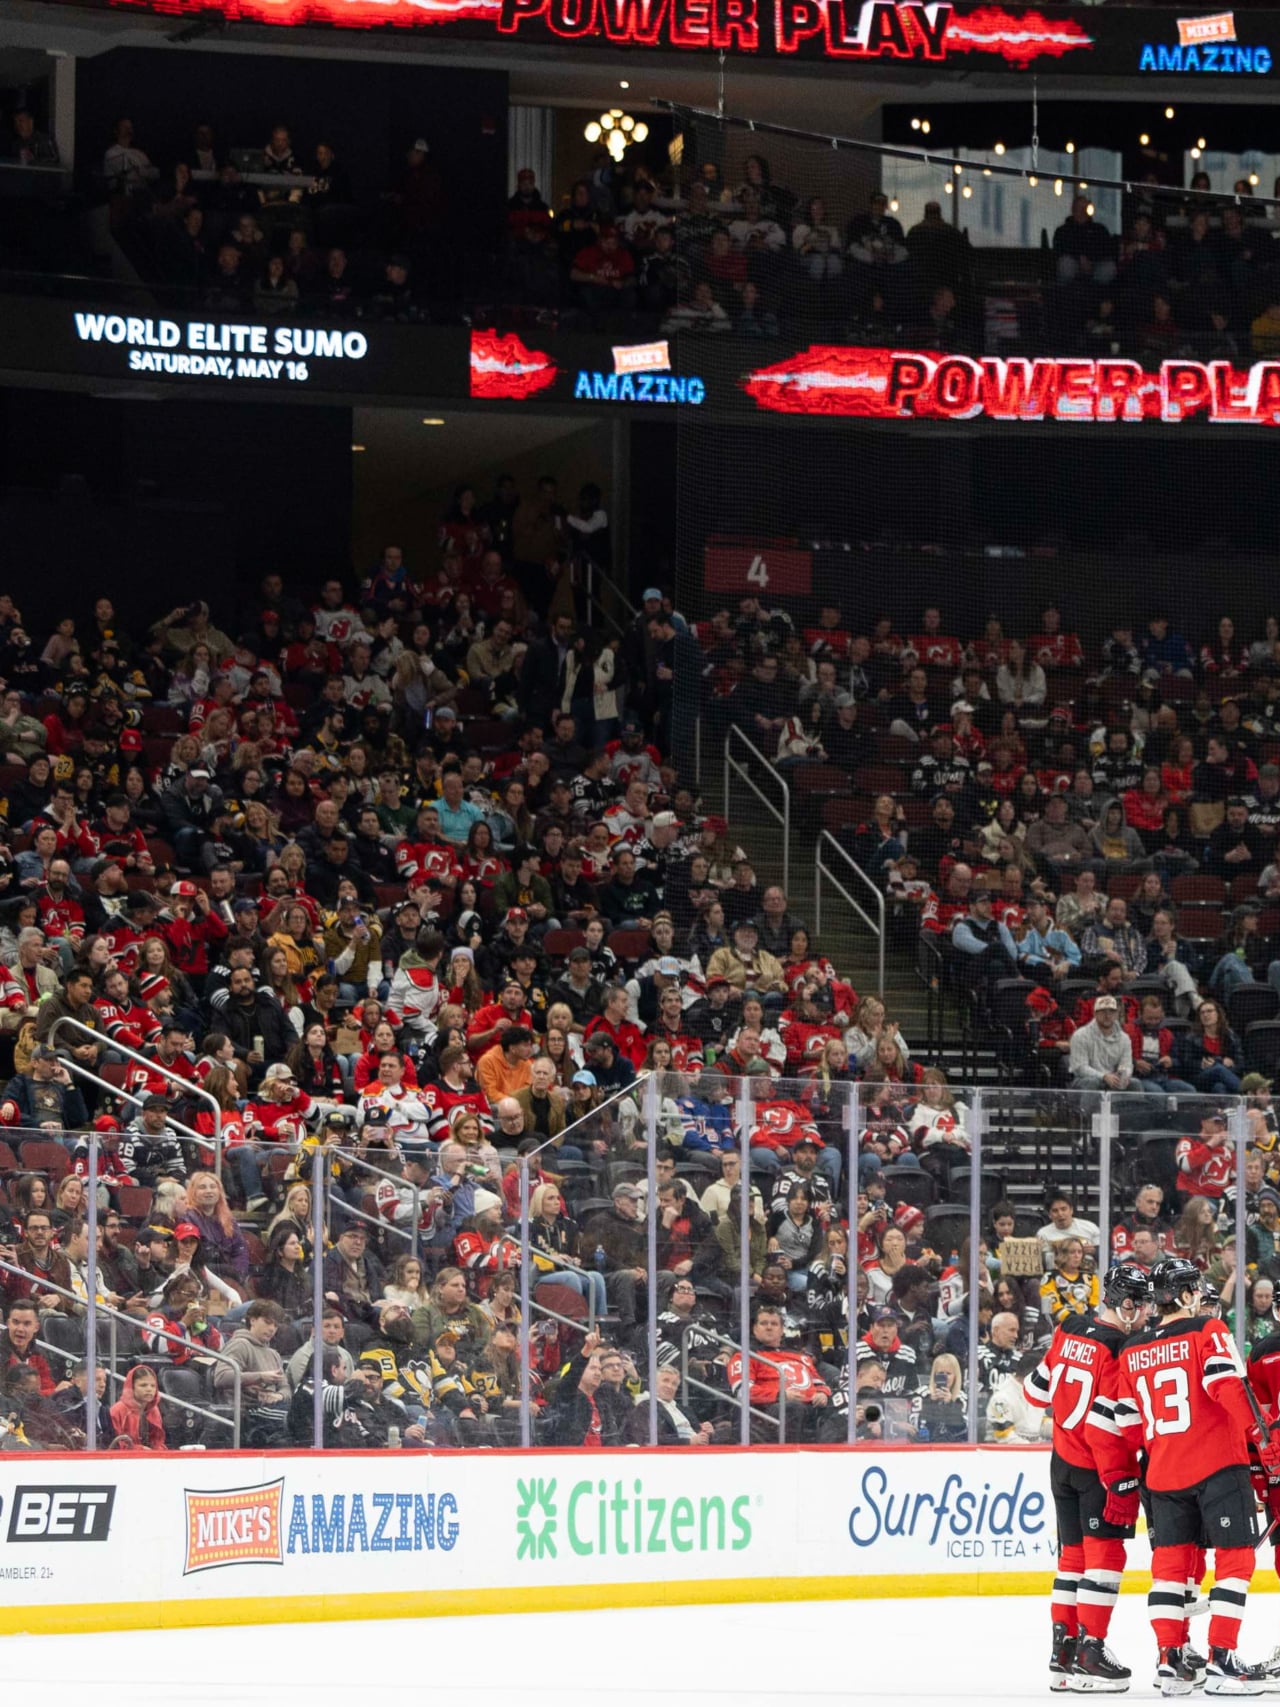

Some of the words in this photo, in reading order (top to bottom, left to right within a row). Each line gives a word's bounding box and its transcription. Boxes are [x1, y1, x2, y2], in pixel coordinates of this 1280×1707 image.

[775, 0, 953, 60] PLAY
[1139, 44, 1273, 73] AMAZING
[73, 312, 181, 348] WORLD
[187, 321, 268, 353] ELITE
[274, 328, 368, 359] SUMO
[129, 350, 234, 379] SATURDAY,
[236, 358, 283, 379] MAY
[285, 361, 309, 381] 16
[574, 370, 706, 404] AMAZING
[887, 353, 1144, 421] POWER
[747, 554, 769, 588] 4
[575, 785, 584, 796] 6
[100, 1006, 117, 1017] 30
[458, 1239, 471, 1256] 13
[1113, 1232, 1126, 1248] 13
[381, 1358, 392, 1370] 5
[1060, 1339, 1097, 1365] NEMEC
[1127, 1340, 1189, 1373] HISCHIER
[476, 1376, 497, 1392] 87
[1050, 1363, 1094, 1430] 17
[1136, 1366, 1191, 1440] 13
[15, 1492, 108, 1535] BET
[197, 1505, 271, 1550] MIKE'S
[286, 1491, 460, 1554] AMAZING
[567, 1477, 752, 1556] Citizens
[848, 1465, 1045, 1547] Surfside
[946, 1540, 984, 1558] ICED
[991, 1540, 1025, 1557] TEA
